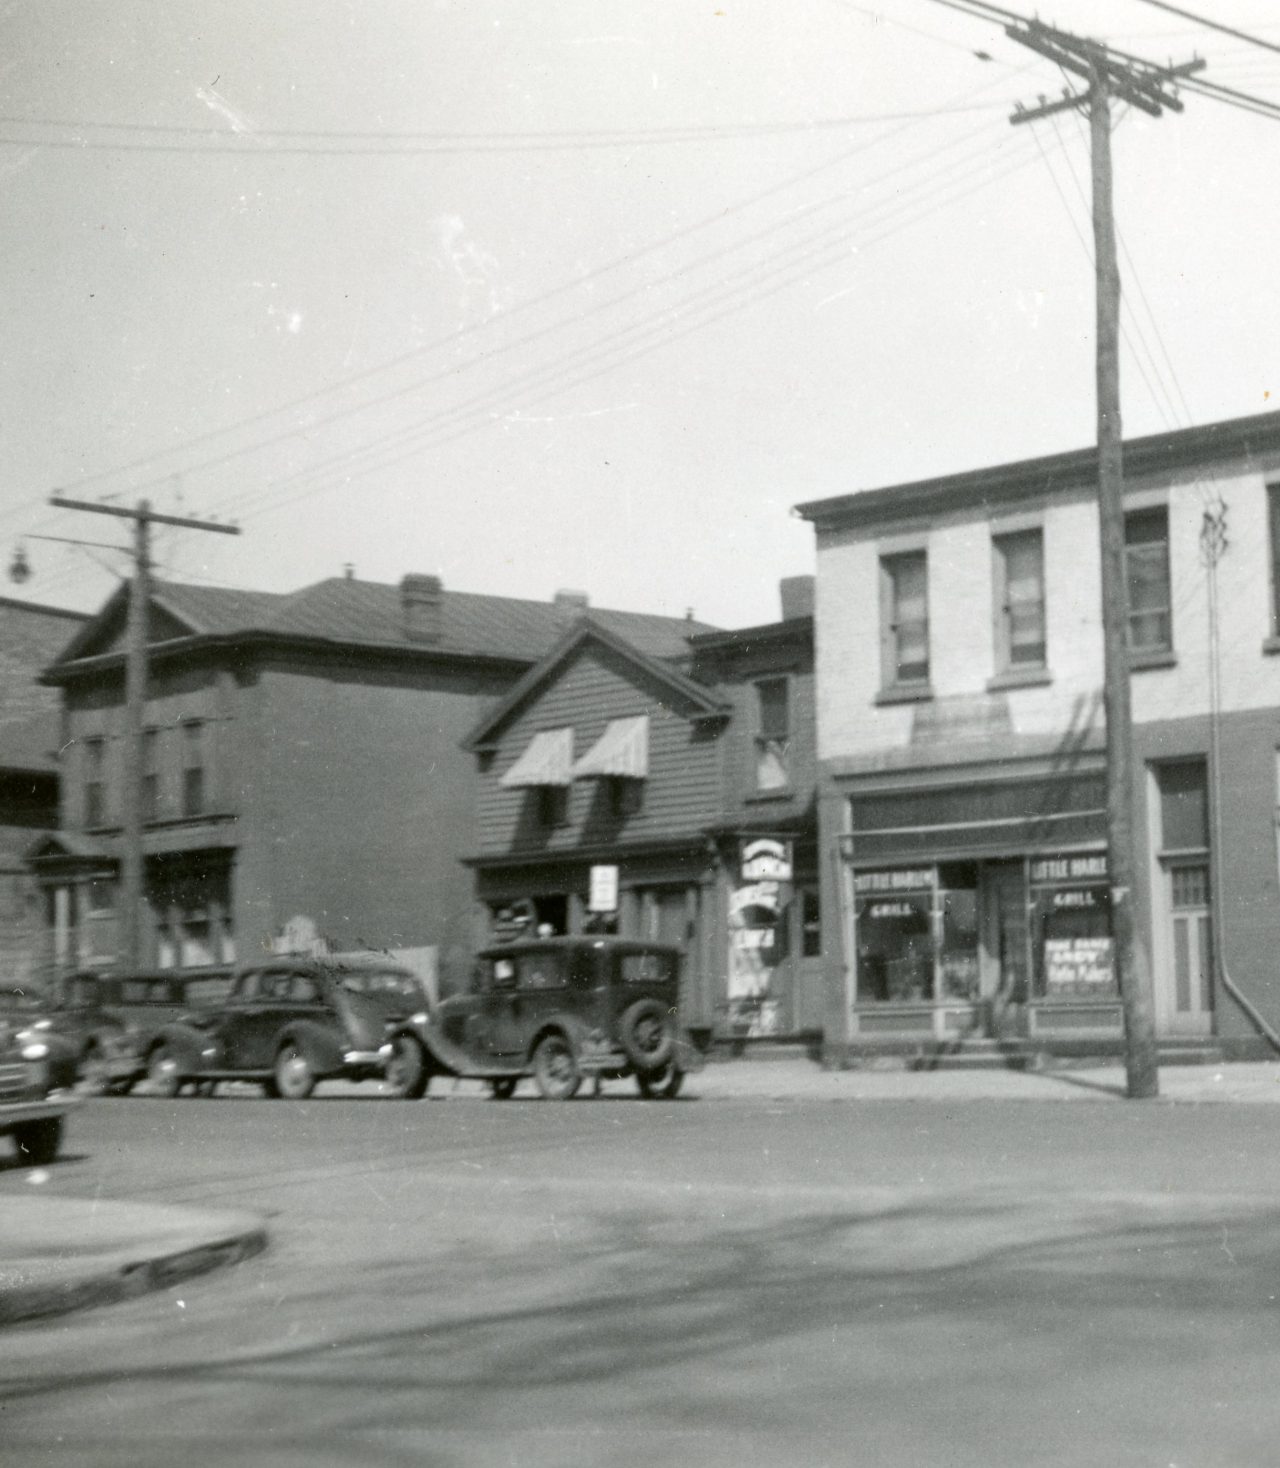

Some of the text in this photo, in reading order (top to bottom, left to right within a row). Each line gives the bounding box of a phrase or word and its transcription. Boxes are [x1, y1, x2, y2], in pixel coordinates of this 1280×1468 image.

[1032, 857, 1107, 879] LITTLE HARLE
[1053, 891, 1095, 906] GRILL
[869, 903, 912, 918] GRILL
